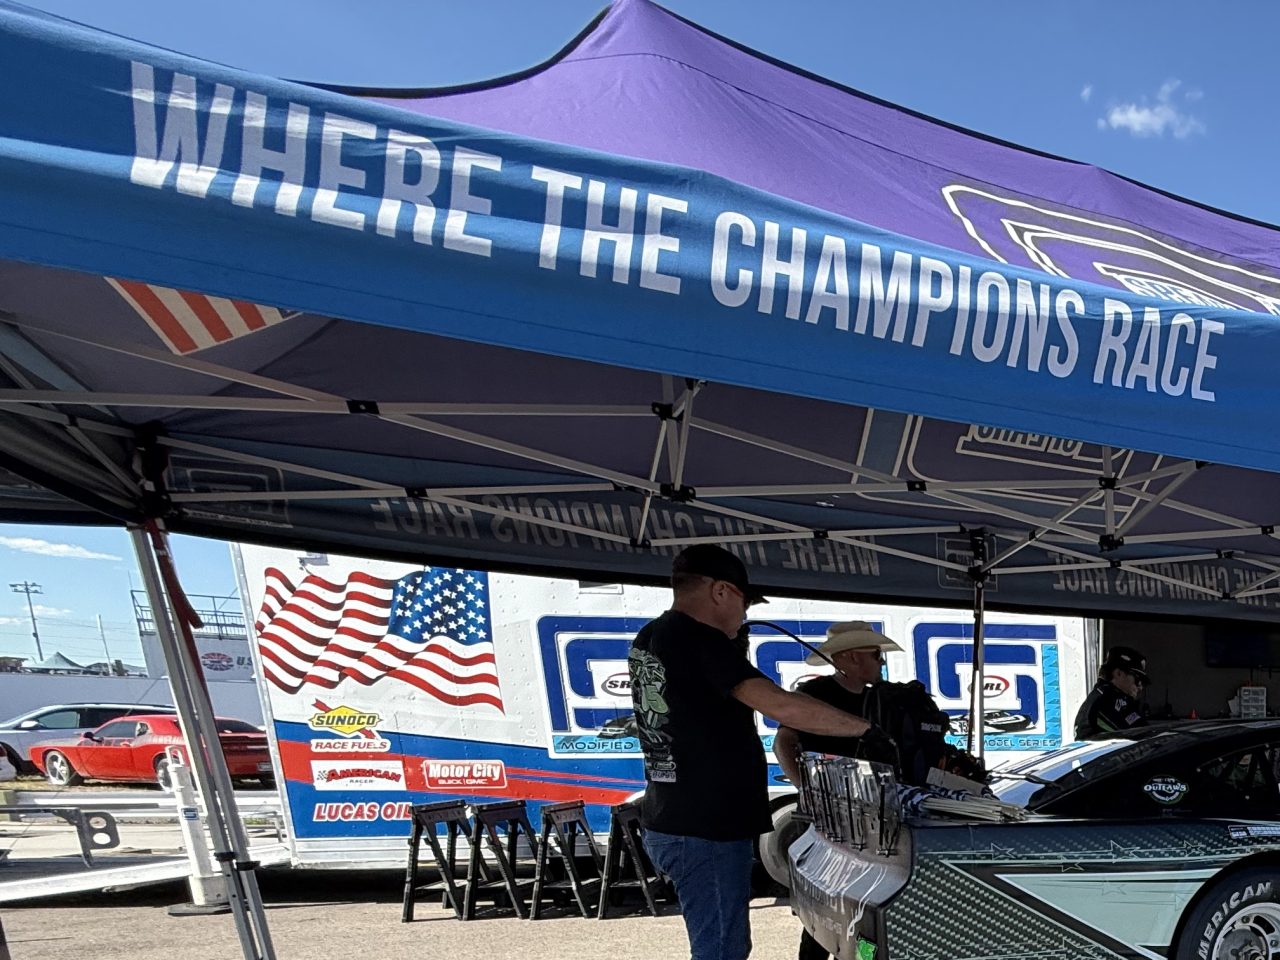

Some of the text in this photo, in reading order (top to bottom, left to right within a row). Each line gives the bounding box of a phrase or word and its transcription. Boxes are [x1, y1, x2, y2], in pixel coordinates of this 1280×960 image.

[129, 60, 1226, 402] WHERE THE CHAMPIONS RACE
[607, 679, 631, 689] SR
[315, 715, 377, 726] SUNOCO
[314, 741, 388, 750] RACE FUELS
[560, 741, 634, 750] MODIFIED
[1018, 739, 1057, 747] SERIES
[326, 768, 402, 783] AMERICAN
[428, 763, 501, 782] Motor City
[1143, 782, 1188, 794] OUTLAWS
[313, 802, 413, 821] LUCAS OIL
